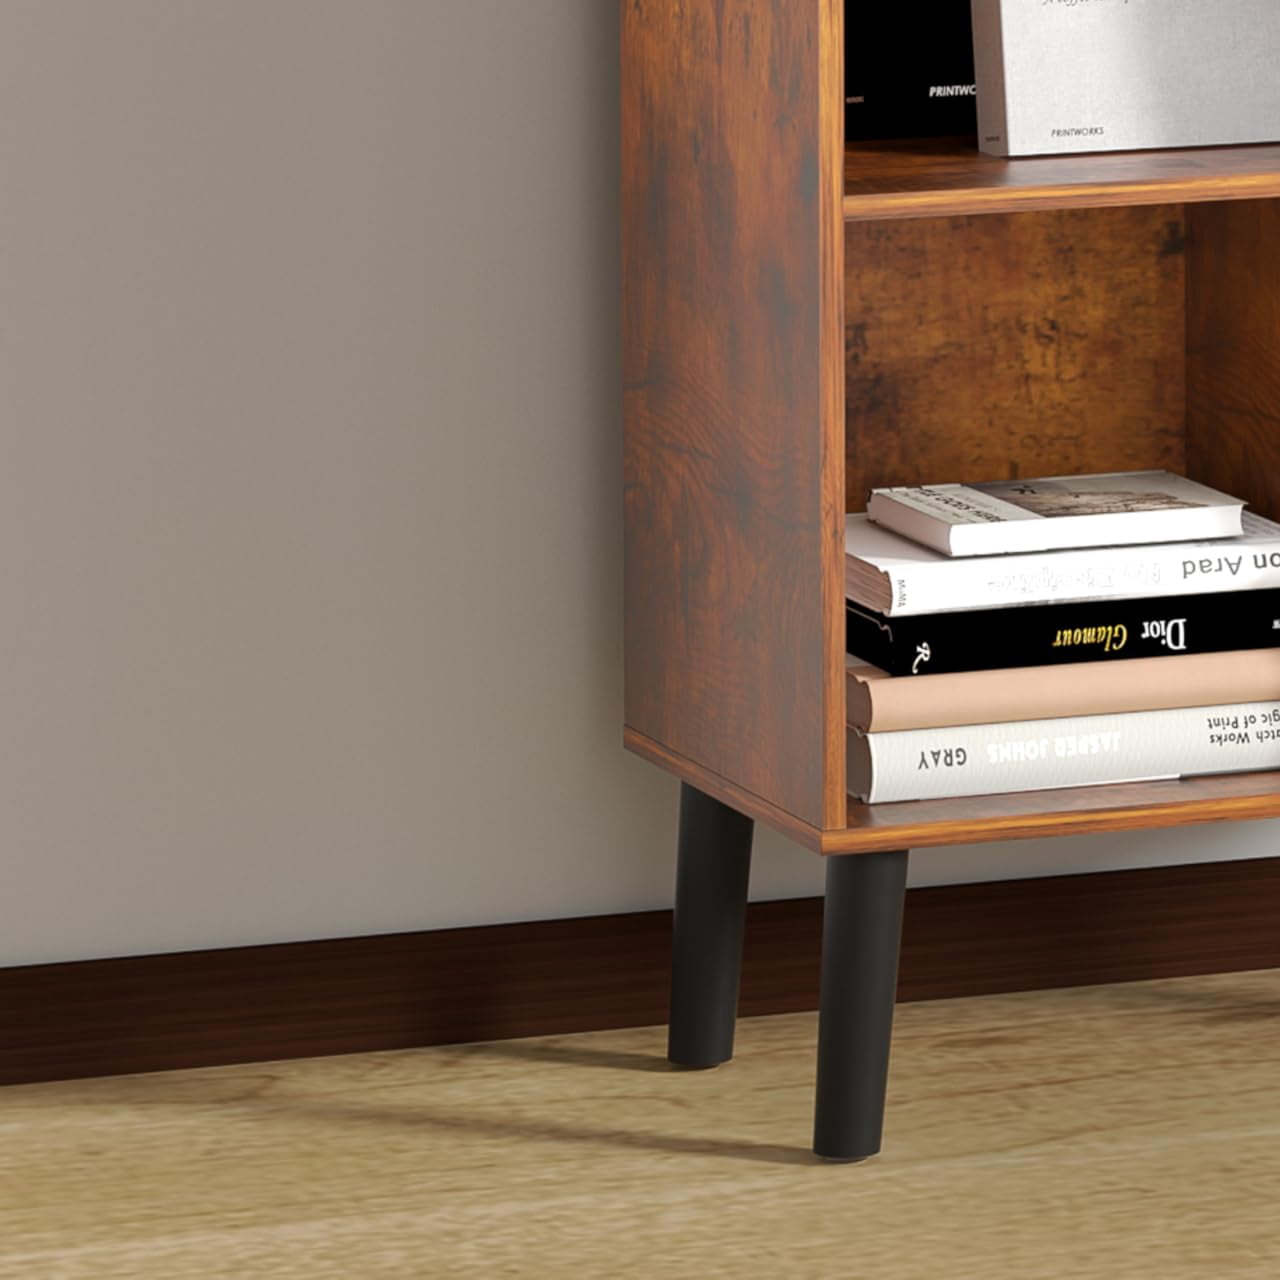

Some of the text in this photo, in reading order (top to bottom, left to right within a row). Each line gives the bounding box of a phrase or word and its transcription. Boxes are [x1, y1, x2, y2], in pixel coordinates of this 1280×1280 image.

[1051, 126, 1105, 138] PRINTWORKS
[1182, 555, 1243, 579] Arad
[1052, 618, 1187, 652] Dior Glamour
[1207, 716, 1239, 731] Print
[1244, 714, 1257, 728] of
[986, 731, 1121, 764] JASPER JOHNS
[1209, 731, 1251, 747] Works
[918, 747, 967, 770] GRAY
